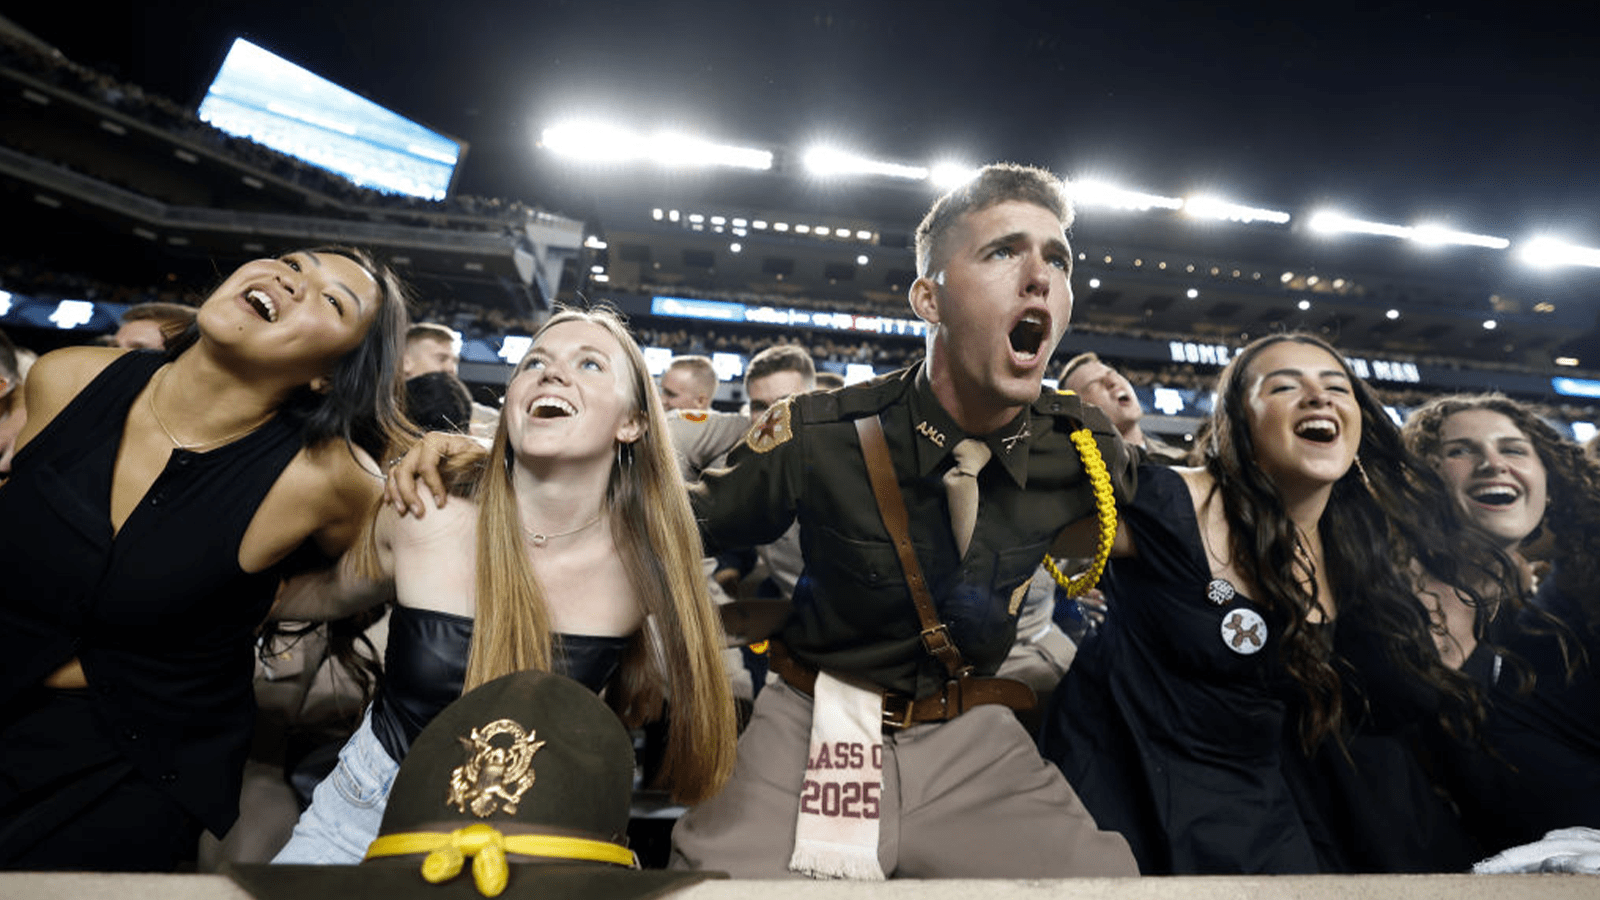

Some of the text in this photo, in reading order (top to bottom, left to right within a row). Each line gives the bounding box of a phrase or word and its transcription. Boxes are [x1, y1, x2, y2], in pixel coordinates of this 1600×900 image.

[1169, 341, 1231, 365] HOME
[1371, 360, 1420, 383] MAN
[801, 780, 881, 819] 2025
